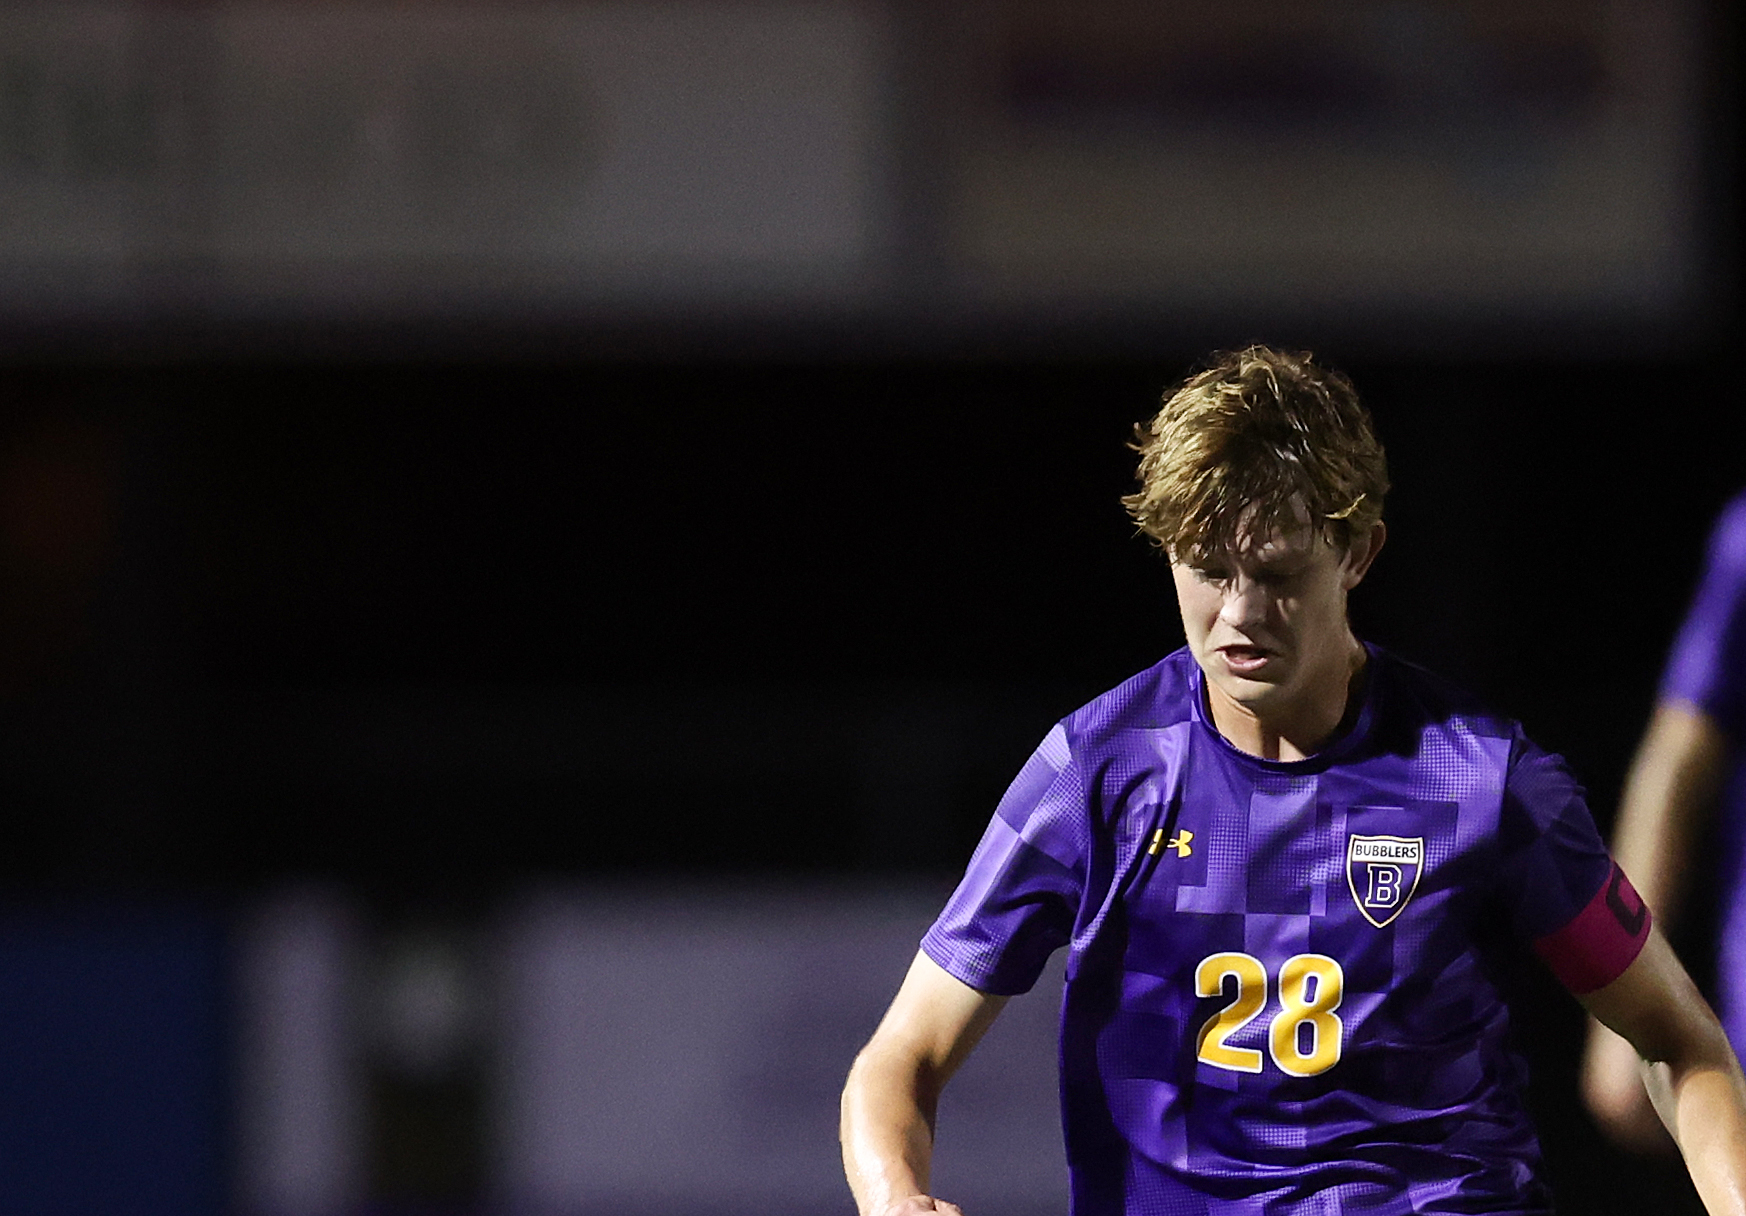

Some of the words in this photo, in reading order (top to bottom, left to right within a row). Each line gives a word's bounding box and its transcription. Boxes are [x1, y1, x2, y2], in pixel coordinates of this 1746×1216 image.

[1356, 845, 1417, 858] BUBBLERS
[1365, 863, 1402, 908] B
[1194, 952, 1344, 1077] 28
